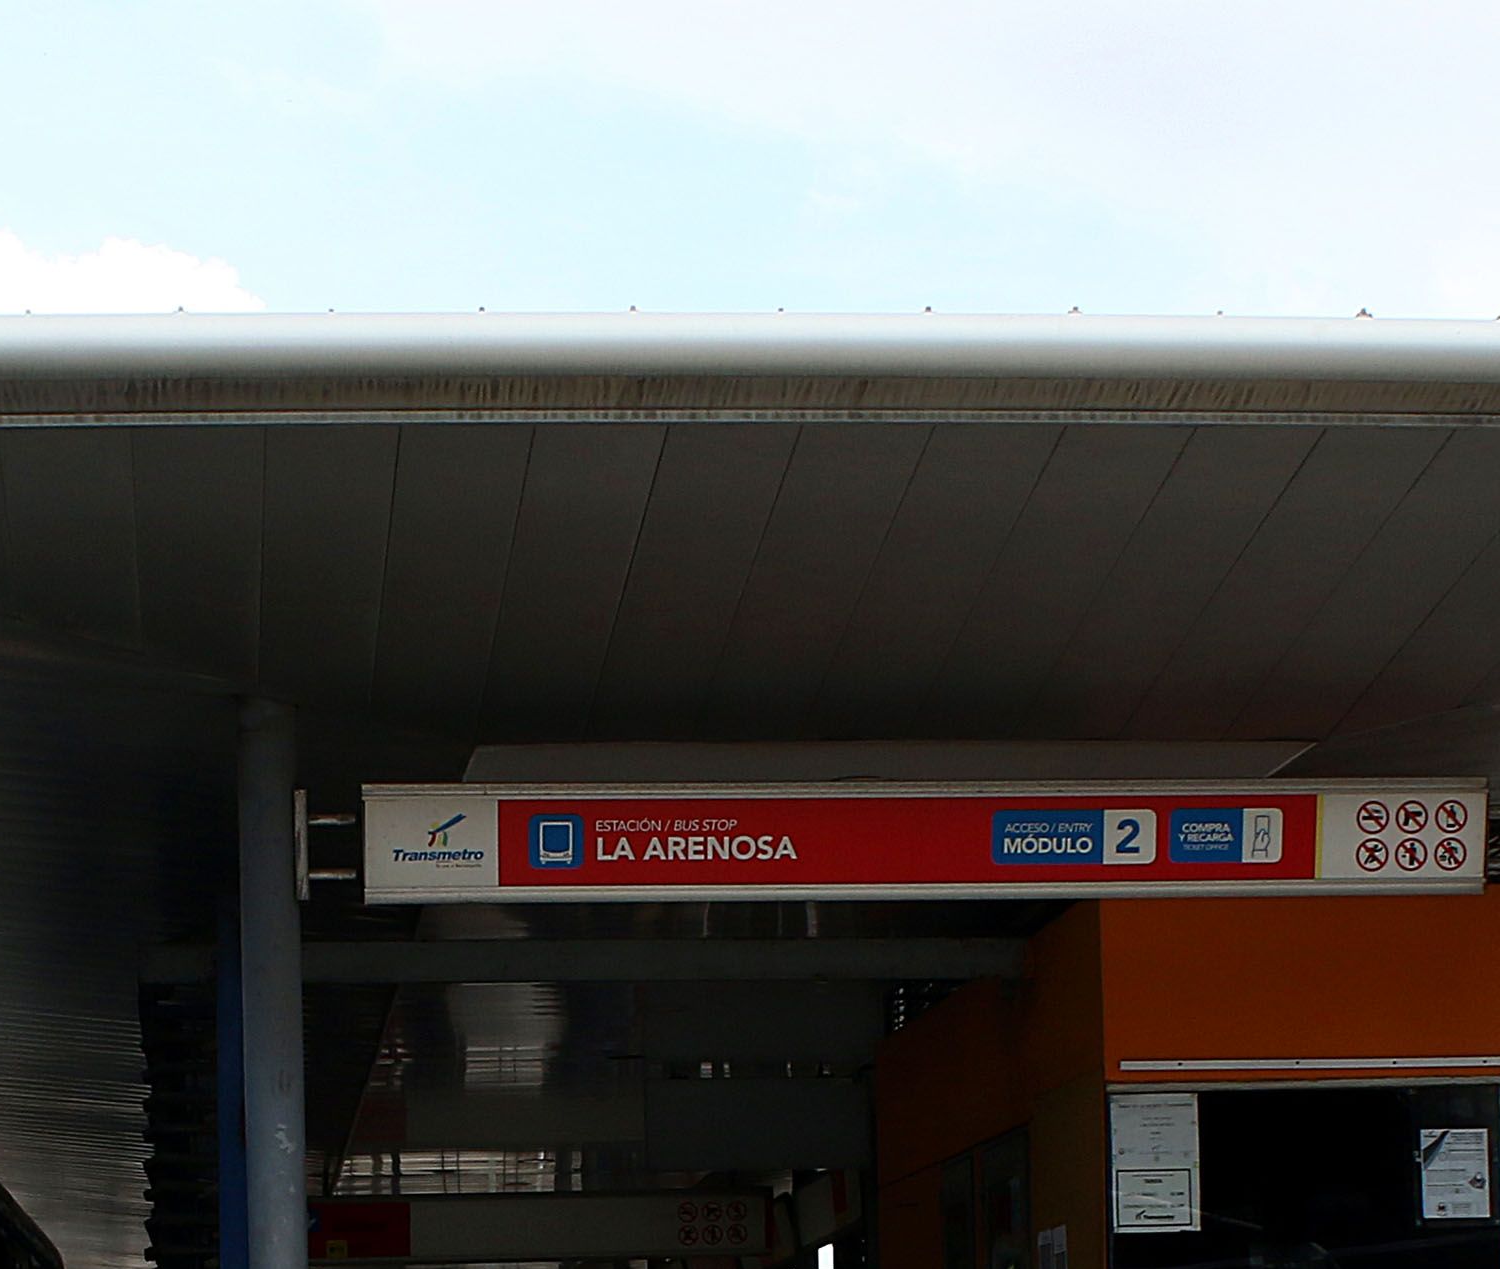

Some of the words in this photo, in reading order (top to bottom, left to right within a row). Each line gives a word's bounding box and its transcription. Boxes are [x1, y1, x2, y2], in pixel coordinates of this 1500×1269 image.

[595, 817, 661, 832] ESTACIÓN
[673, 819, 700, 832] BUS
[702, 819, 738, 831] STOP
[1004, 823, 1049, 833] ACCESO
[1058, 822, 1092, 833] ENTRY
[1182, 822, 1231, 833] COMPRA
[1115, 818, 1141, 854] 2
[1178, 833, 1186, 842] Y
[1187, 832, 1235, 842] RECARGA
[596, 836, 636, 861] LA
[642, 835, 798, 861] ARENOSA
[1003, 834, 1093, 855] MÓDULO
[392, 848, 484, 862] Transmetro
